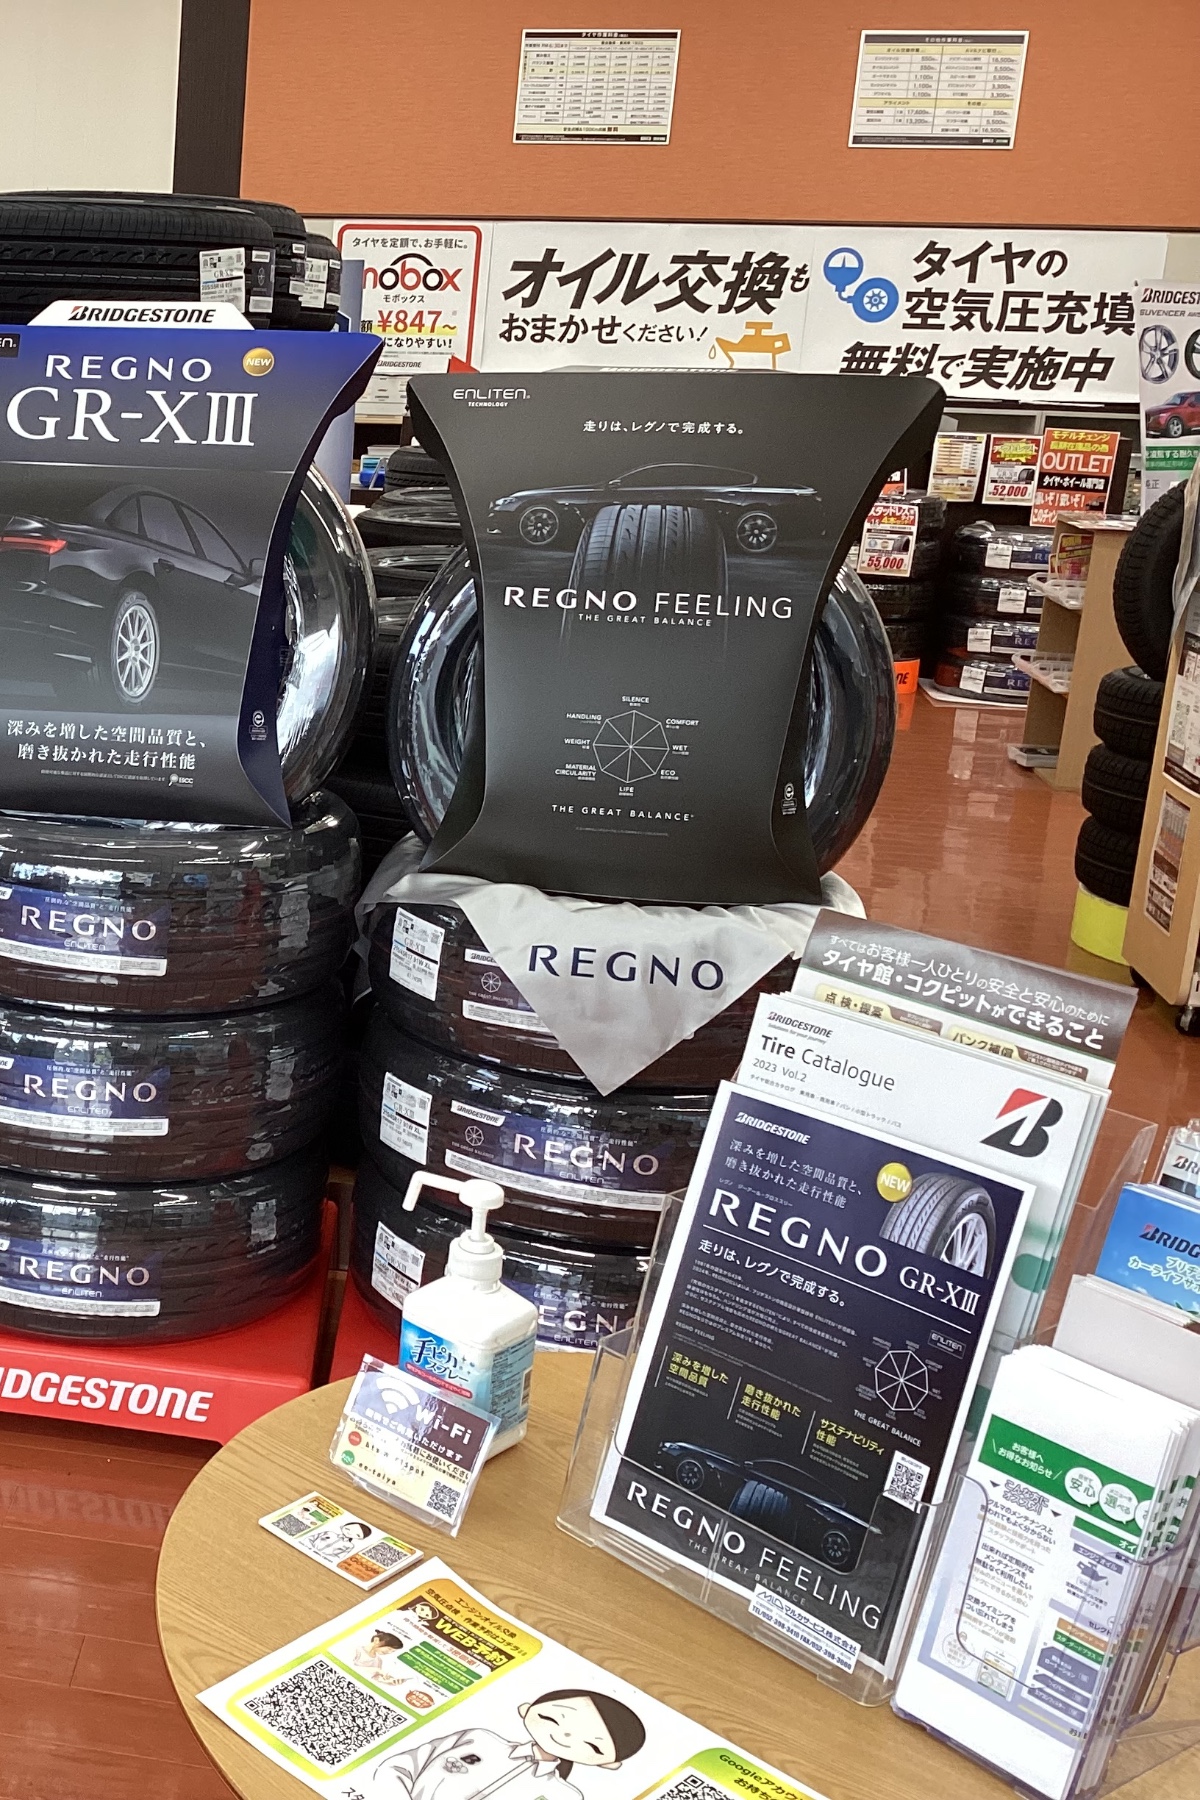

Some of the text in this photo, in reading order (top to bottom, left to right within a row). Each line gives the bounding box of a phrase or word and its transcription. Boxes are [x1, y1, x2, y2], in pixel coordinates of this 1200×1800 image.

[352, 237, 468, 249] タイヤを定額で、お手軽に。
[913, 240, 1068, 284] タイヤの
[501, 248, 810, 314] オイル交換も
[383, 294, 425, 303] モボックス
[902, 288, 1136, 336] 空気圧充填
[68, 305, 216, 324] BRIDGESTONE
[499, 312, 708, 345] おまかせください!
[45, 354, 212, 382] REGNO
[246, 357, 272, 367] NEW
[839, 341, 1115, 392] 無料で実施中
[583, 420, 745, 436] 走りは、レグノで完成する。
[1052, 431, 1110, 442] モデルチェンジ
[1042, 452, 1113, 473] OUTLET
[504, 586, 793, 620] REGNO FEELING
[578, 613, 712, 627] THE GREAT BALANCE
[566, 712, 602, 720] HANDLING
[665, 718, 699, 726] COMFORT
[7, 719, 206, 748] 深みを増した空間品質と、
[564, 738, 590, 746] WEIGHT
[17, 743, 196, 770] 磨き抜かれた走行性能
[554, 769, 597, 777] CIRCULARITY
[551, 804, 691, 821] THE GREAT BALANCE
[21, 905, 156, 941] REGNO
[528, 944, 724, 991] REGNO
[829, 934, 1108, 1027] すべてはお客様一人ひとりの安全と安心のために
[822, 948, 1105, 1051] タイヤ館・コクピットができること
[767, 1011, 833, 1038] BRIDGESTONE
[753, 1057, 807, 1083] 2023 Vol.2
[760, 1034, 896, 1092] Tire Catalogue
[24, 1074, 157, 1102] REGNO
[456, 1104, 501, 1122] BRIDGESTONE
[734, 1111, 811, 1145] BRIDGESTONE
[513, 1133, 659, 1175] REGNO
[729, 1138, 863, 1197] 深みを増した空間品質と、
[559, 1171, 604, 1183] ENLITEN
[724, 1156, 847, 1210] 磨き抜かれた走行性能
[880, 1173, 911, 1193] NEW
[708, 1187, 888, 1278] REGNO
[19, 1257, 150, 1287] REGNO
[698, 1238, 846, 1308] 走りは、レグノで完成する。
[61, 1287, 102, 1297] ENLITEN
[412, 1338, 457, 1368] 手ピカ
[932, 1332, 963, 1352] ENLITEN
[426, 1363, 469, 1381] スプレー
[668, 1363, 708, 1389] 空間品質
[671, 1350, 730, 1385] 深みを増した
[741, 1395, 780, 1421] 走行性能
[744, 1384, 801, 1418] 磨き抜かれた
[416, 1405, 472, 1445] Wi-Fi
[816, 1429, 836, 1447] 性能
[820, 1417, 885, 1456] サステナビリティ
[854, 1409, 921, 1447] THE GREAT BALANCE
[998, 1447, 1053, 1479] お得なお知らせ
[1011, 1442, 1044, 1463] お客様へ
[1070, 1477, 1095, 1499] 安心
[987, 1499, 1054, 1535] クルマのメンテナンスと
[1104, 1494, 1131, 1515] 選べる
[627, 1481, 882, 1631] REGNO FEELING
[981, 1543, 1035, 1574] 出来れば定期的な
[984, 1553, 1027, 1579] メンテナンスを
[1077, 1546, 1119, 1571] エンジンオイル
[688, 1539, 708, 1555] THE
[755, 1571, 807, 1607] BALANCE
[975, 1557, 1033, 1590] 無駄なく利用したい
[454, 1597, 517, 1638] エンジンオイル交換
[965, 1602, 1014, 1633] つい忘れてしまう
[967, 1594, 1016, 1625] 交換タイミングを
[435, 1618, 509, 1666] WEB予約
[785, 1604, 857, 1653] マルカサービス株式会社
